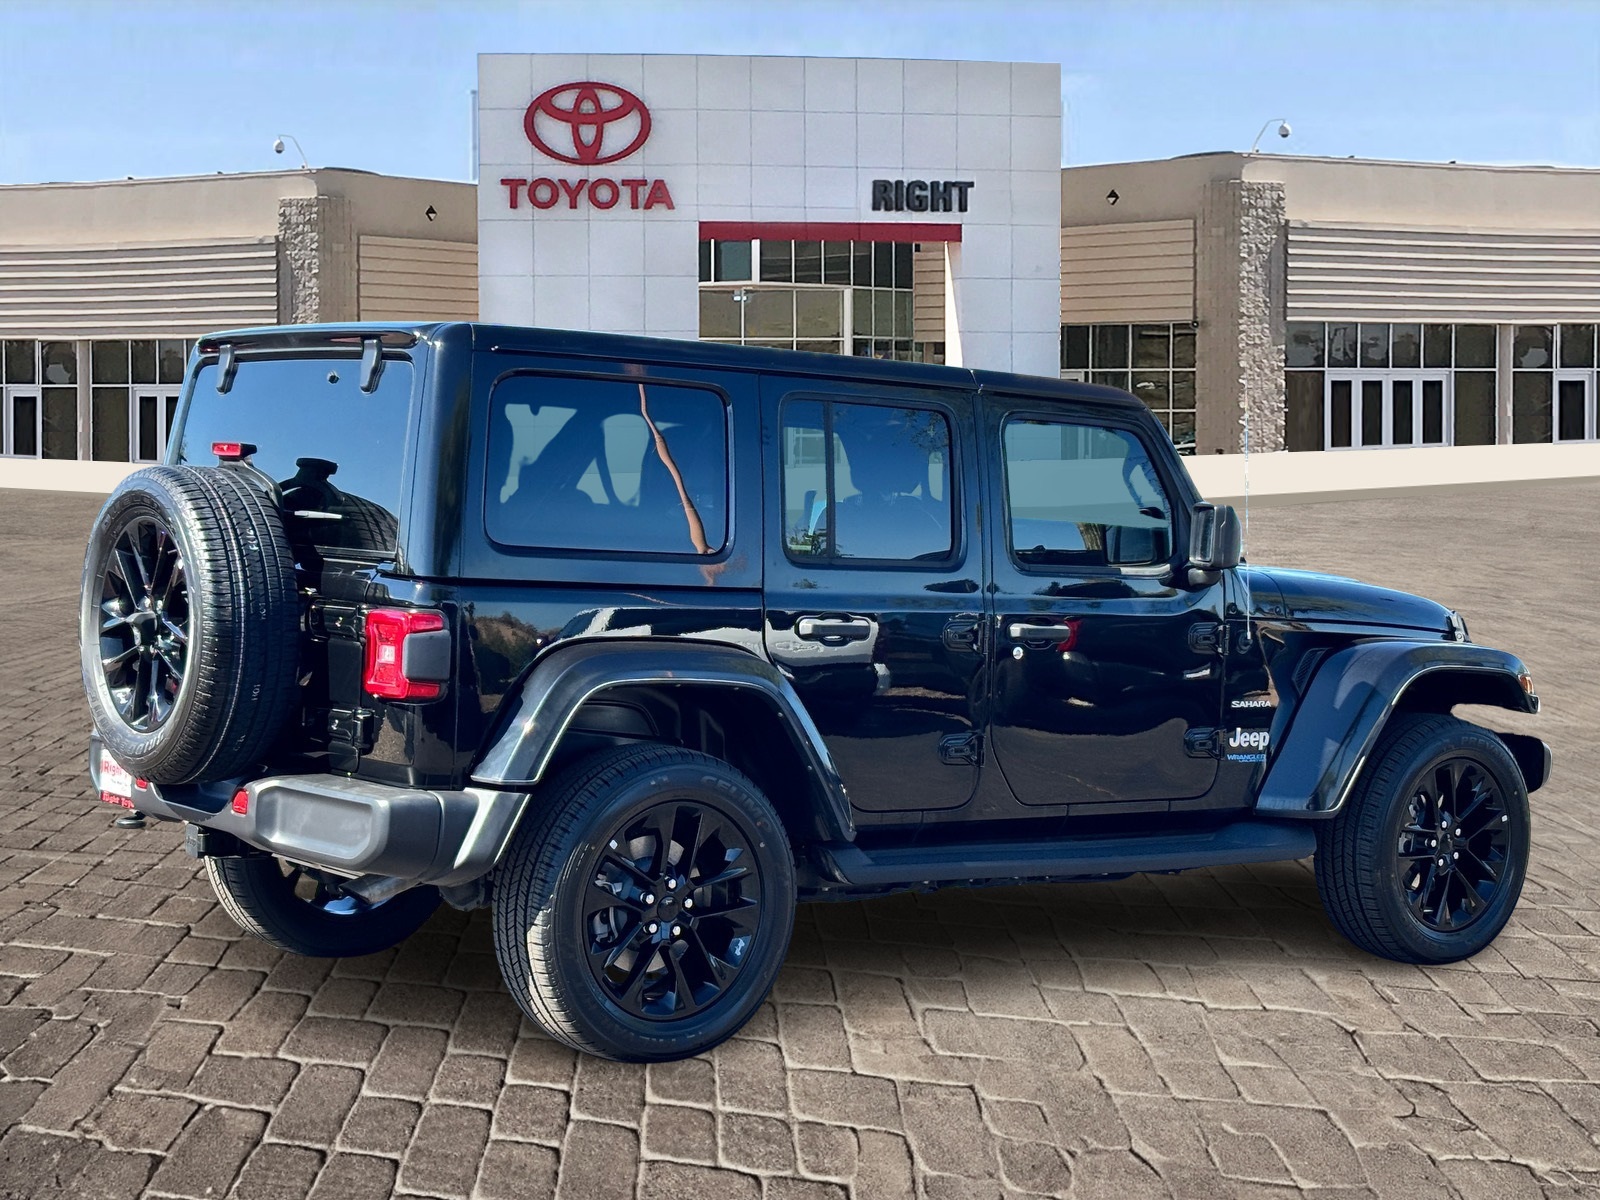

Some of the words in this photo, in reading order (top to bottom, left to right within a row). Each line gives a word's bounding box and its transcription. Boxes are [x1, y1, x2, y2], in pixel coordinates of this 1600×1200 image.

[500, 178, 675, 210] TOYOTA
[871, 179, 975, 213] RIGHT
[1231, 700, 1272, 708] SAHARA
[1229, 727, 1270, 751] Jeep
[1226, 753, 1266, 761] WRANGLER
